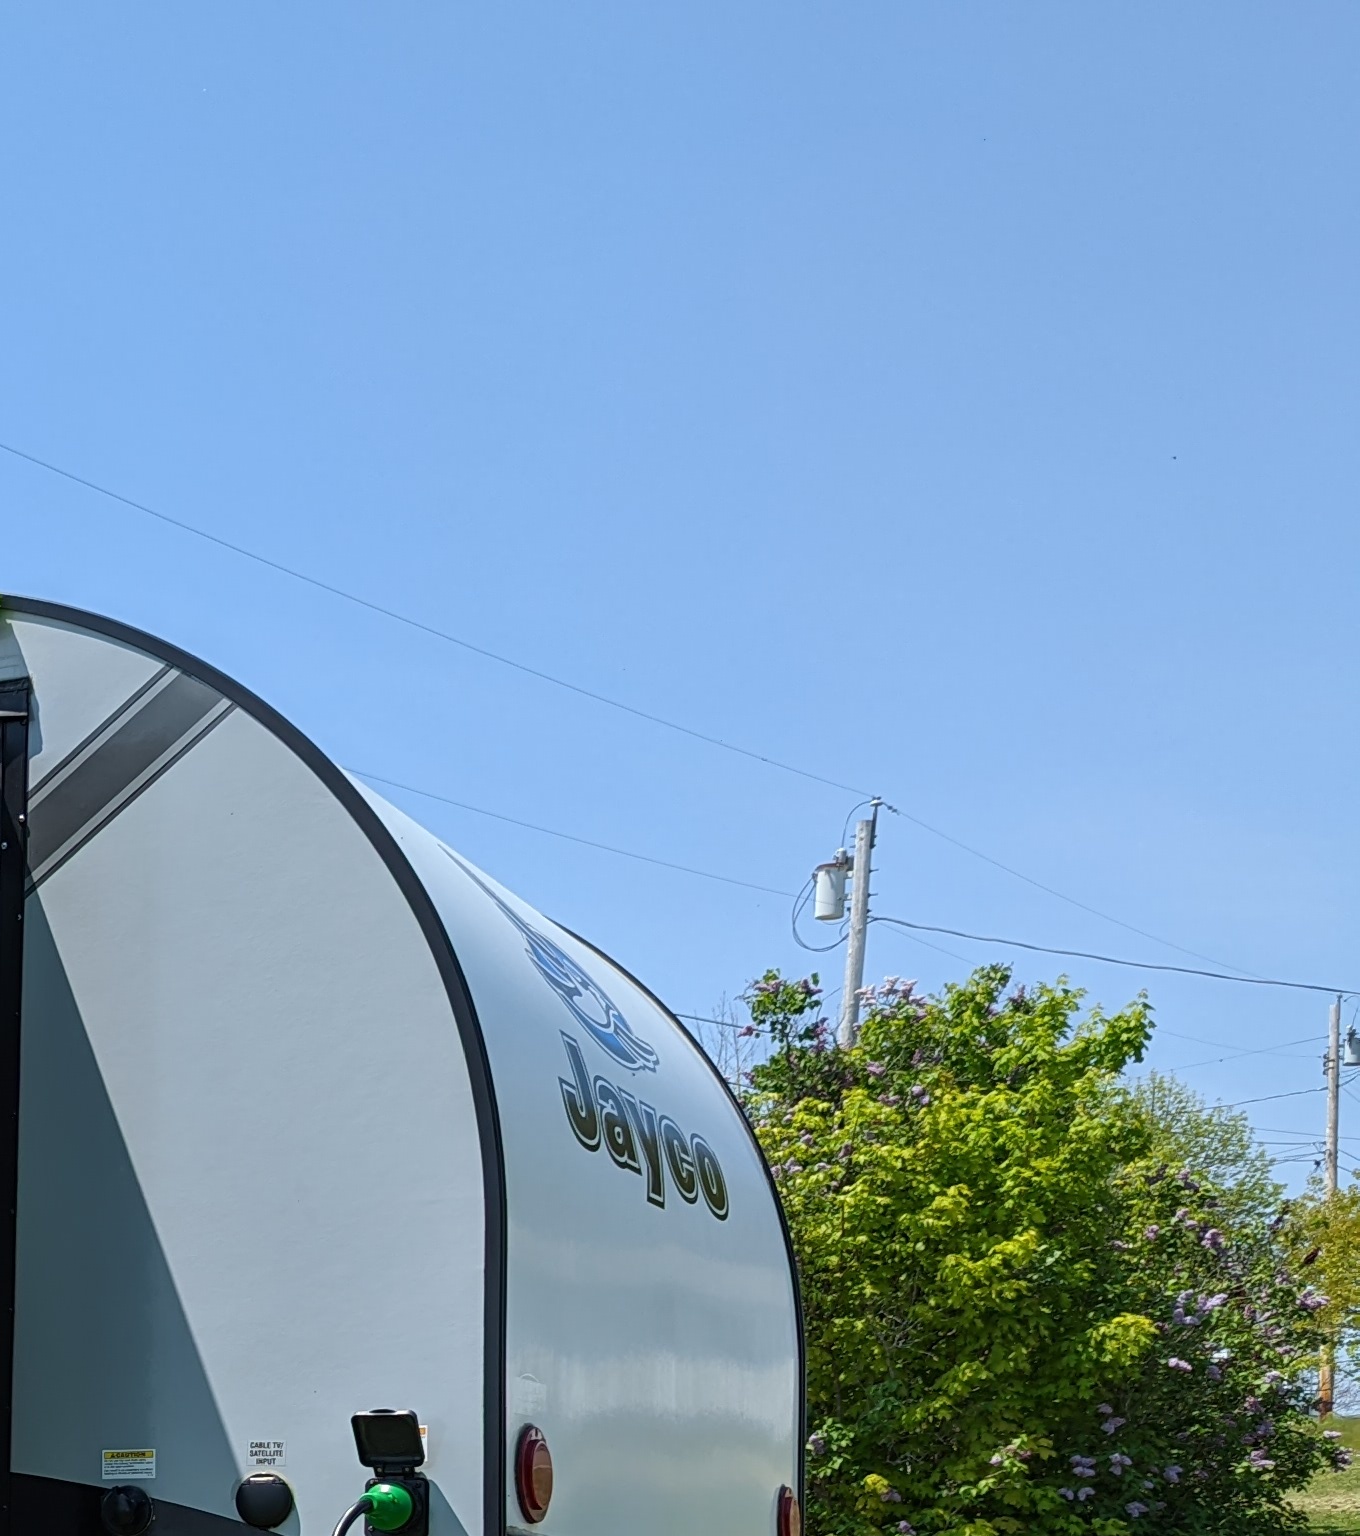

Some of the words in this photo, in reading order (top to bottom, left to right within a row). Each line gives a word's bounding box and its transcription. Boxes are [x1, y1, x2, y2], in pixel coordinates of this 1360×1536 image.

[557, 1029, 730, 1221] Jayco
[250, 1441, 271, 1449] CABLE
[249, 1449, 284, 1457] SATELLITE
